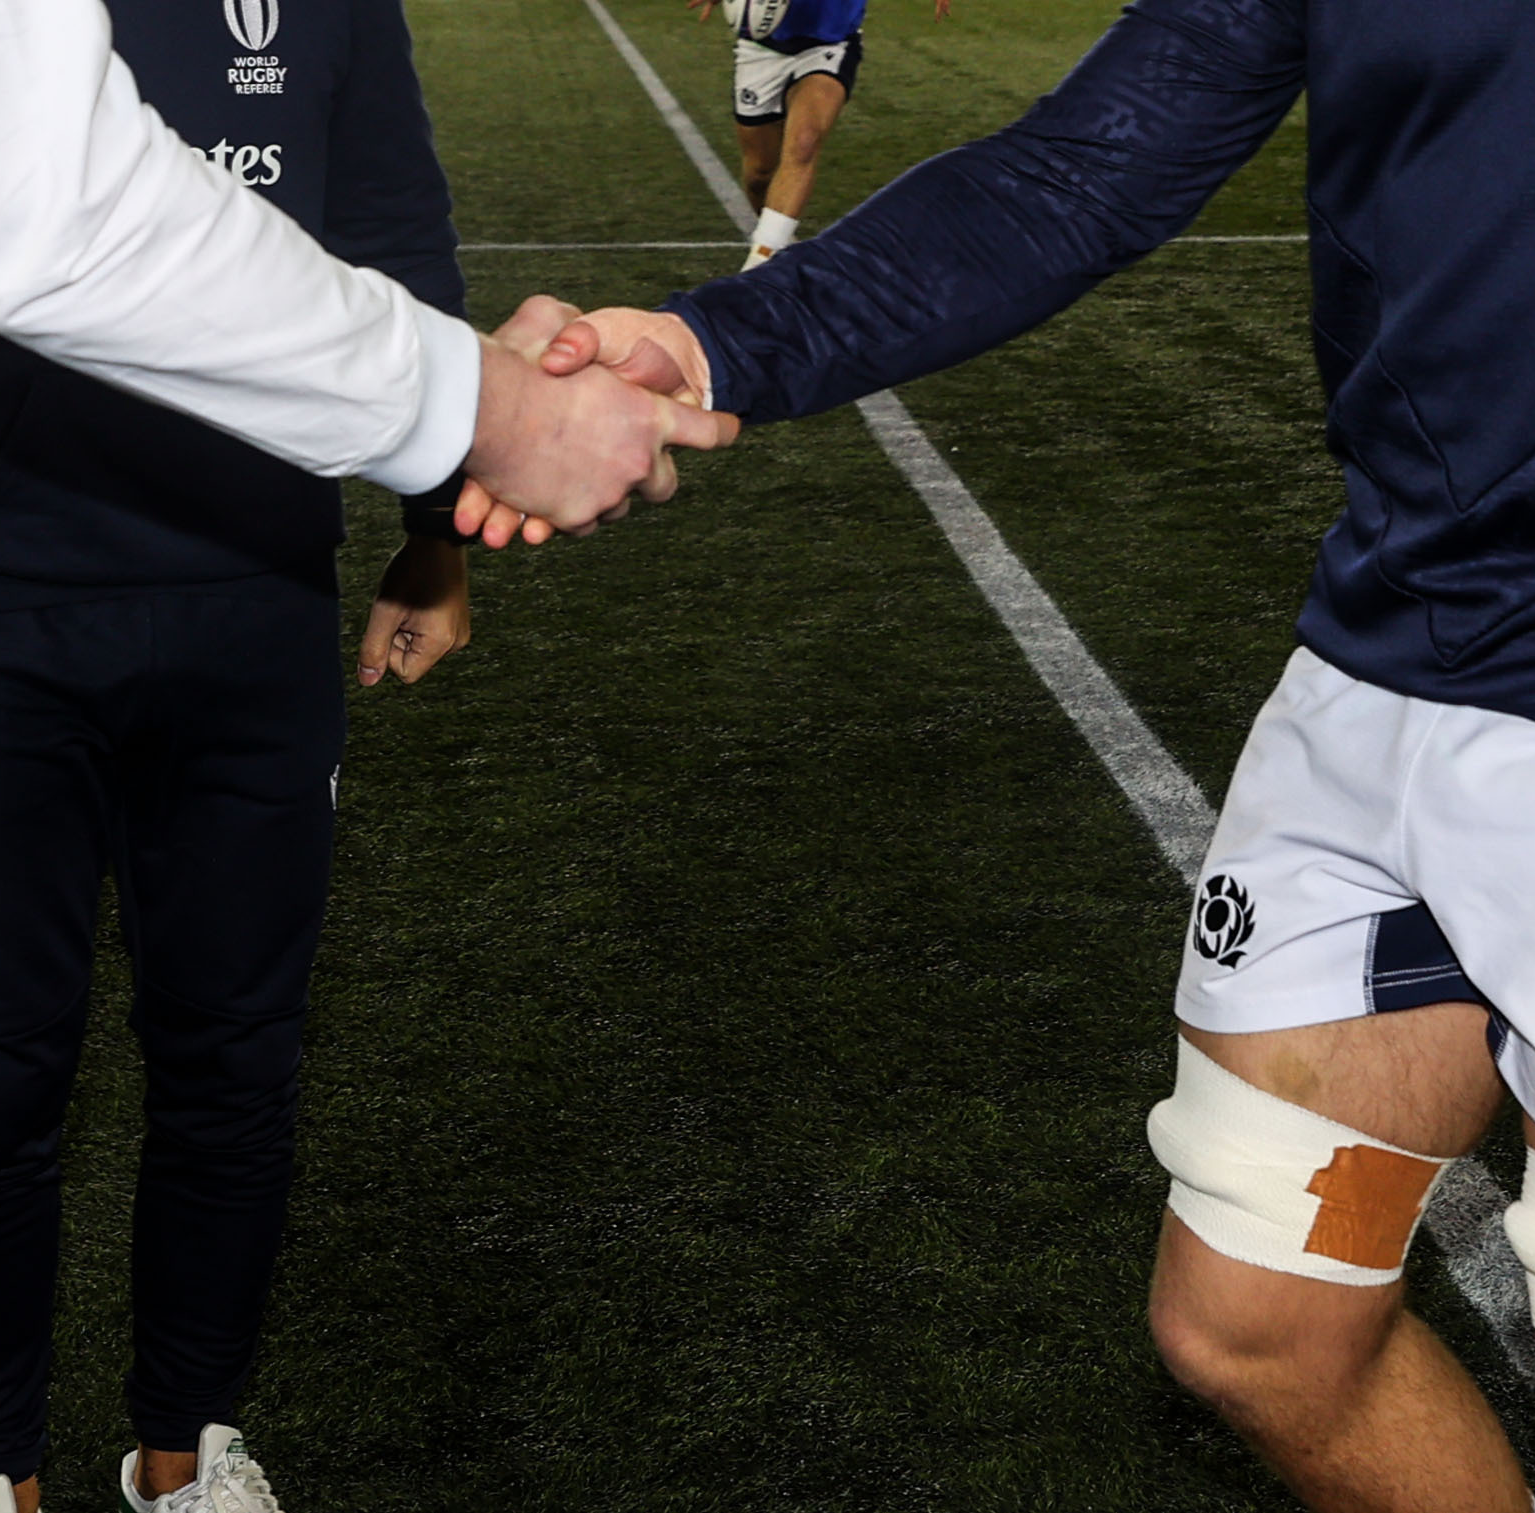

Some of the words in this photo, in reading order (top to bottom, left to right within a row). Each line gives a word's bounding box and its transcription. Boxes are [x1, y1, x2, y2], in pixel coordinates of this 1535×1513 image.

[234, 56, 279, 67] WORLD
[227, 67, 288, 84] RUGBY
[235, 83, 284, 95] REFEREE
[191, 137, 283, 186] tes
